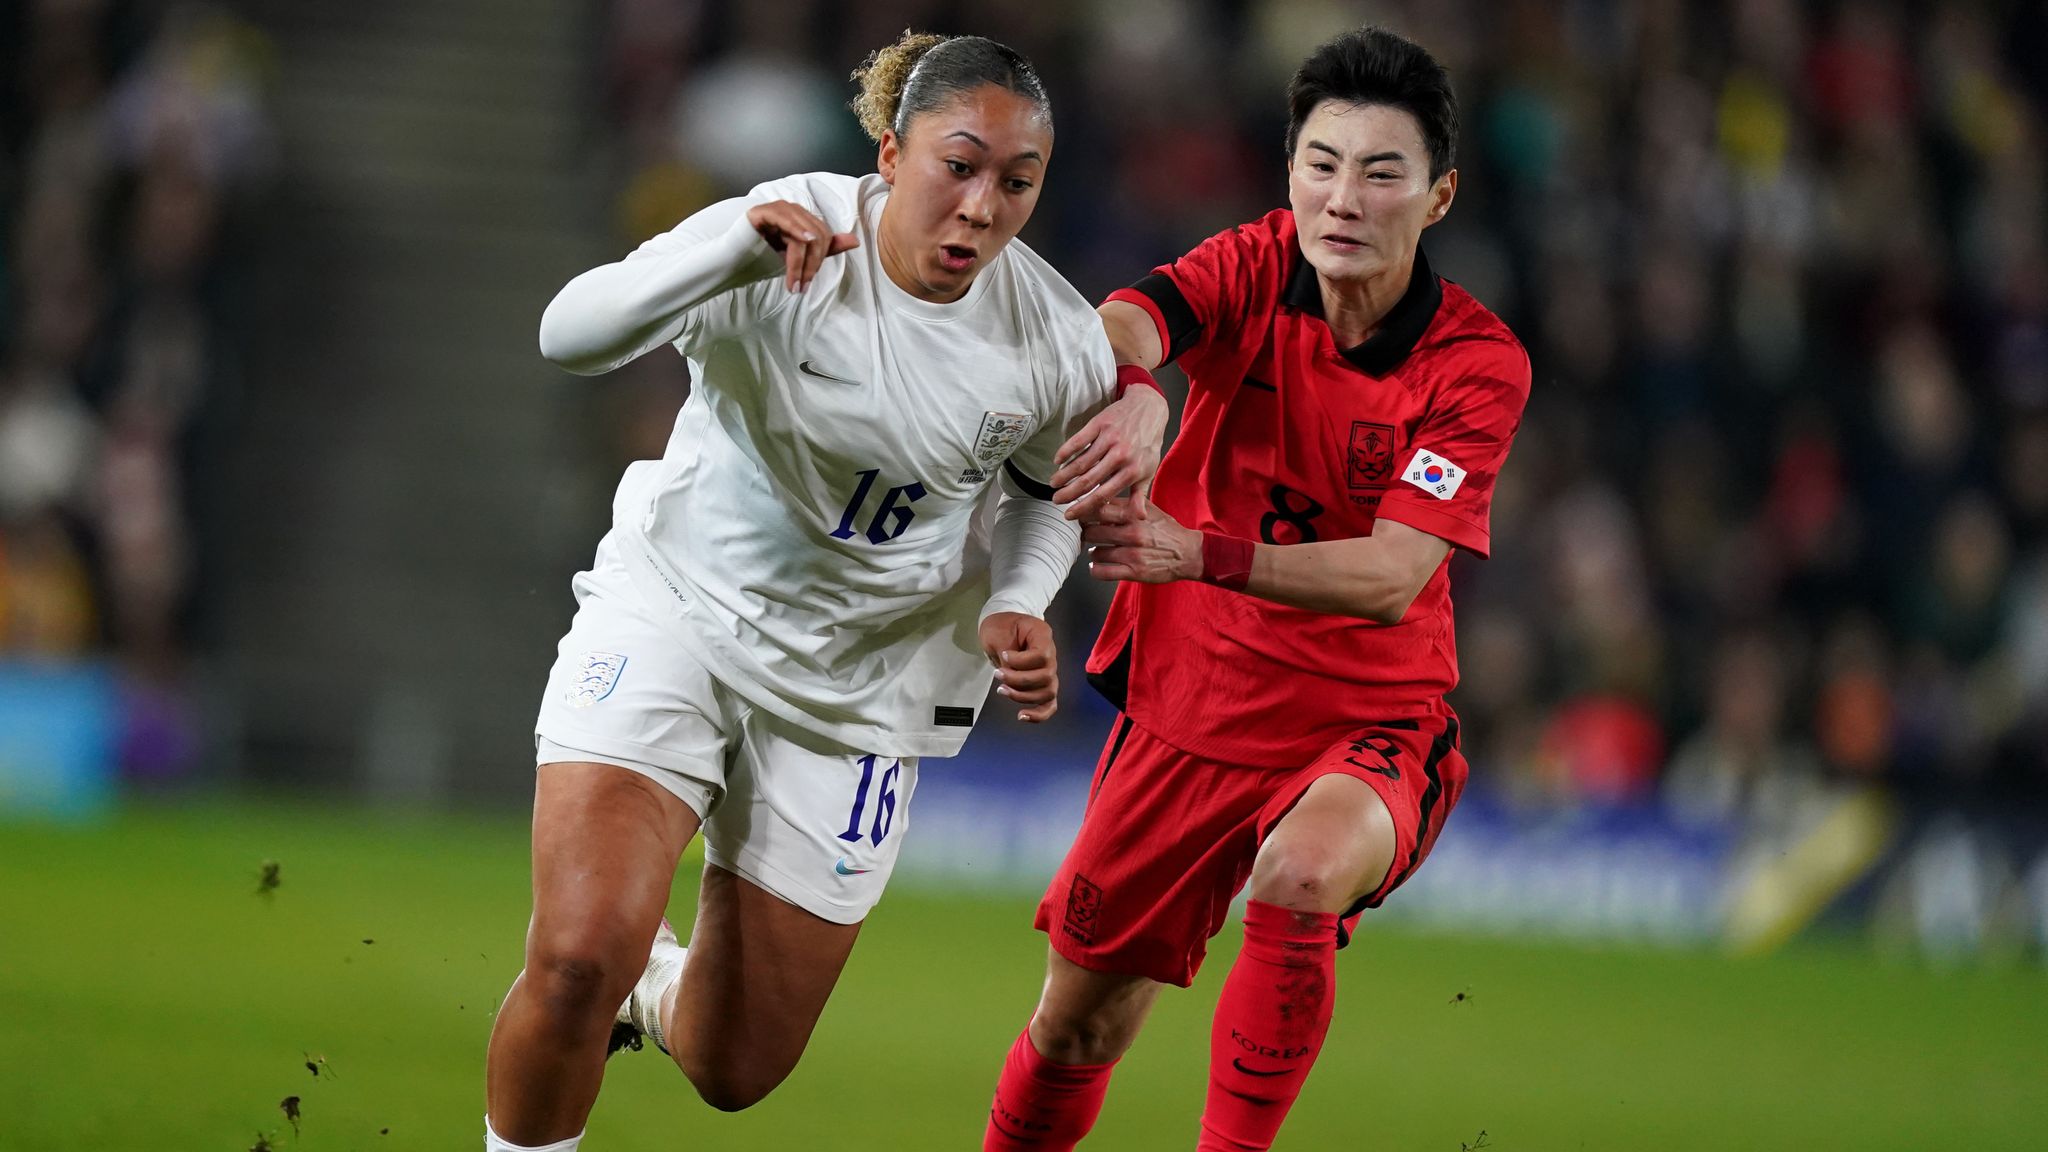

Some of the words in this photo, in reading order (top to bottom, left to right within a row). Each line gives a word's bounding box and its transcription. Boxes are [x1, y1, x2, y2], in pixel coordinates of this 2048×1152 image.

[829, 469, 927, 545] 16
[1260, 484, 1325, 546] 8
[837, 753, 900, 848] 16
[1232, 1029, 1309, 1059] KOREA
